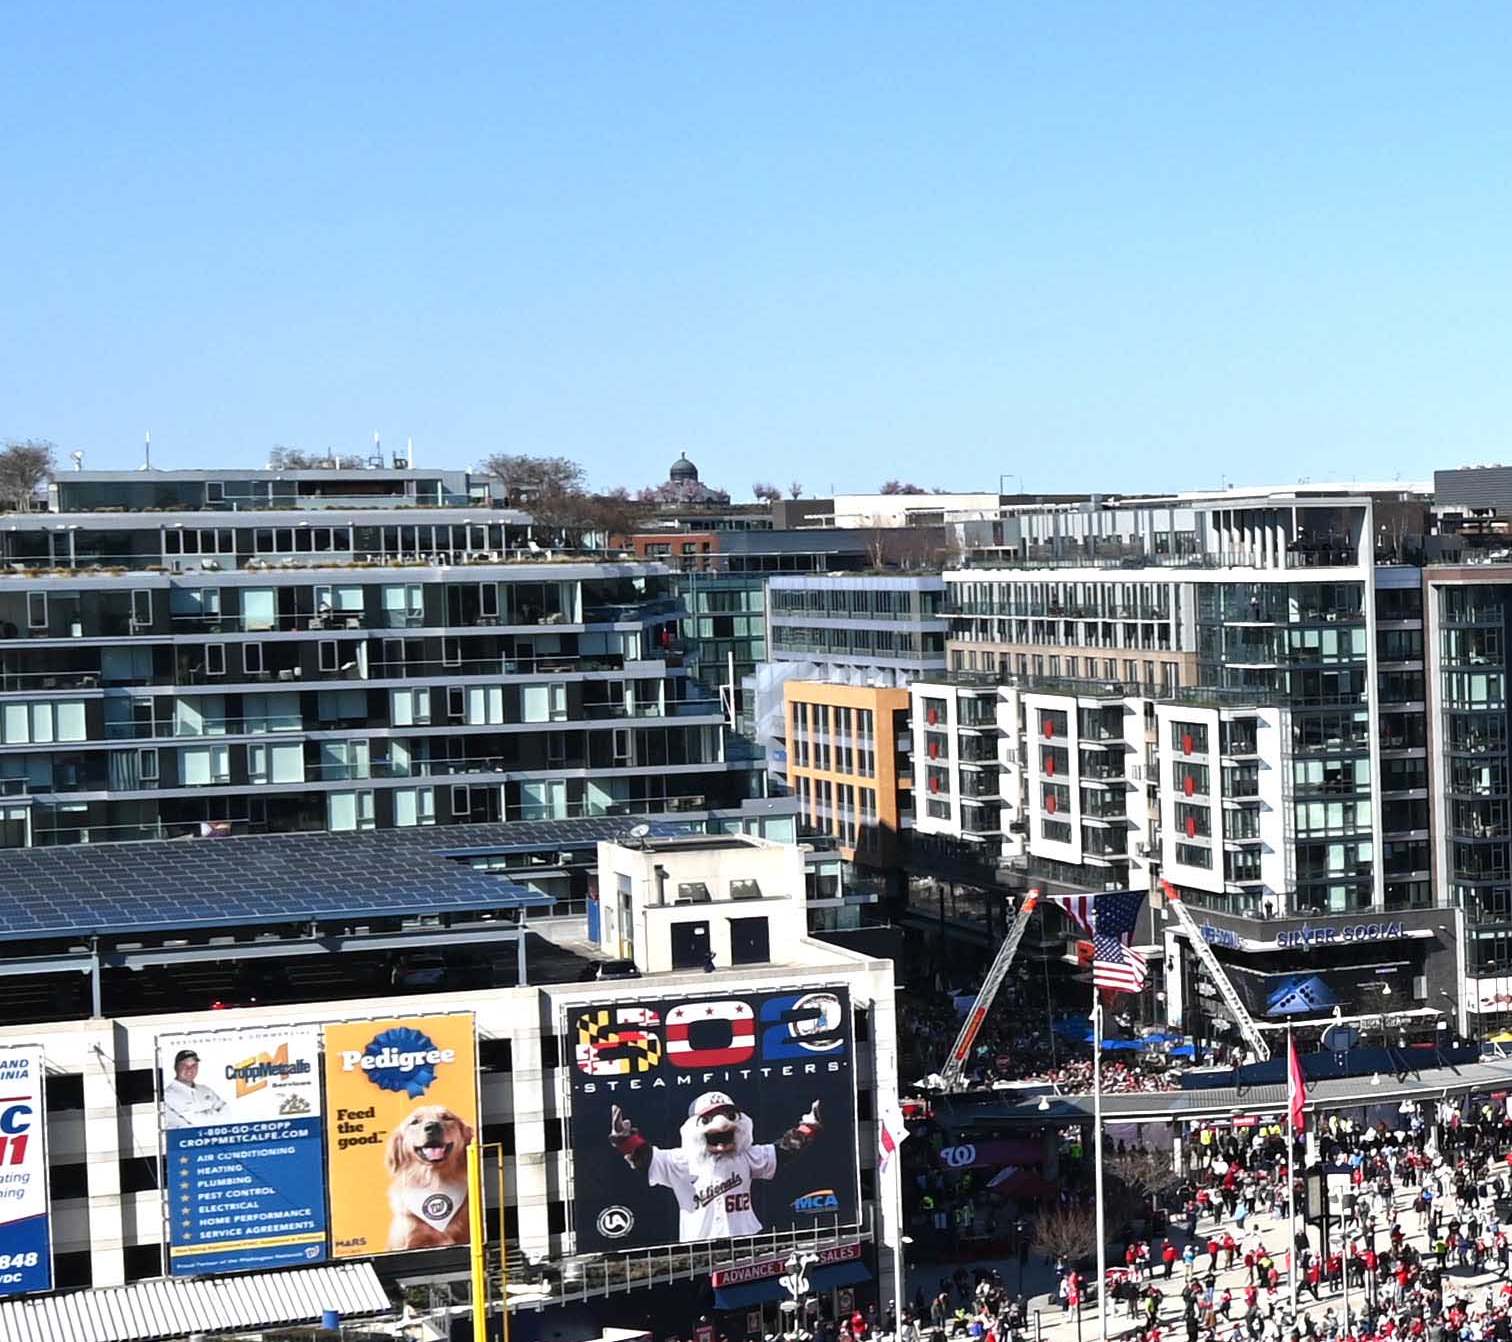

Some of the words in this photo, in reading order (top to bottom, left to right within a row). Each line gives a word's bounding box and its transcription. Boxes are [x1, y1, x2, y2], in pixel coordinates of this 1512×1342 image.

[338, 1047, 457, 1073] Pedigree
[225, 1058, 312, 1084] CroppMetcalfe
[583, 1061, 840, 1094] STEAMFITTERS
[336, 1106, 376, 1121] Feed
[337, 1122, 365, 1134] the
[197, 1153, 215, 1163] AIR
[217, 1146, 297, 1162] CONDITIONING
[197, 1164, 244, 1176] HEATING
[197, 1176, 252, 1189] PLUMBING
[198, 1191, 223, 1202] PEST
[225, 1187, 277, 1200] CONTROL
[724, 1192, 751, 1213] 602
[198, 1201, 260, 1214] ELECTRICAL
[199, 1216, 231, 1227] HOME
[233, 1209, 313, 1224] PERFORMANCE
[199, 1226, 243, 1240] SERVICE
[245, 1221, 316, 1236] AGREEMENTS
[819, 1246, 855, 1264] SALES
[721, 1261, 775, 1285] ADVANCE
